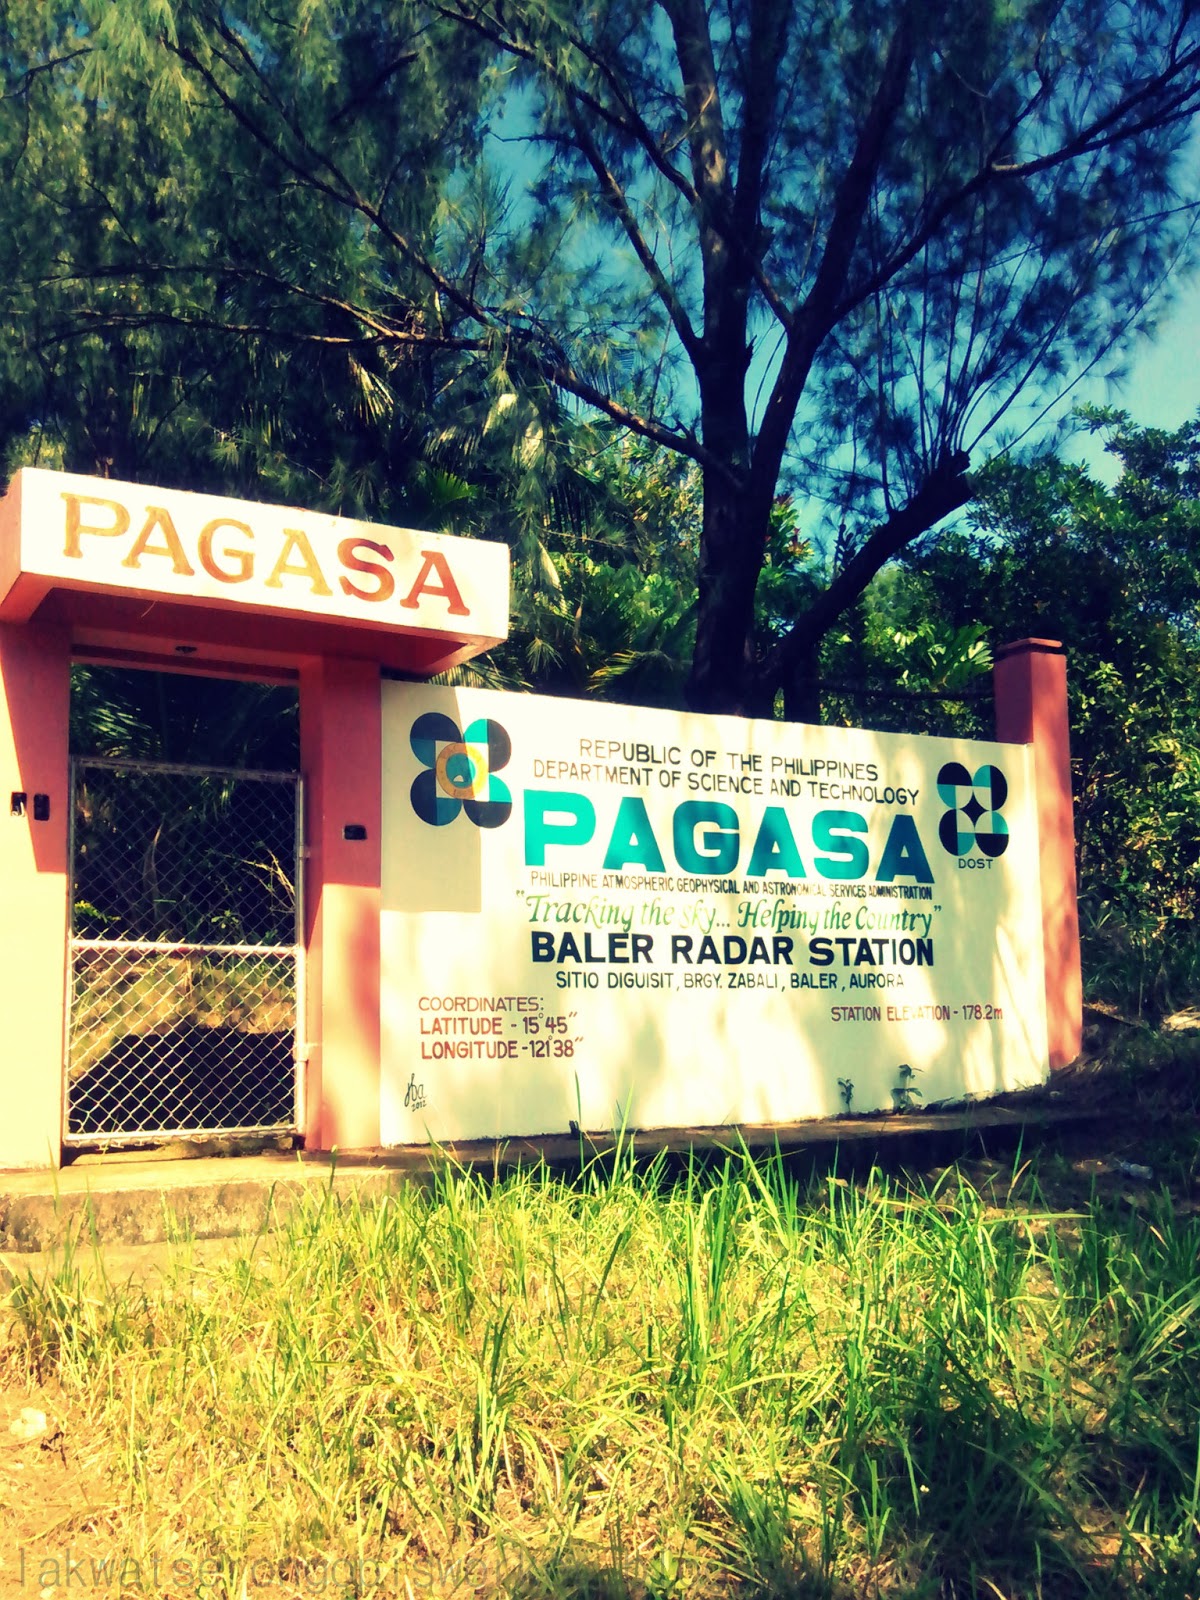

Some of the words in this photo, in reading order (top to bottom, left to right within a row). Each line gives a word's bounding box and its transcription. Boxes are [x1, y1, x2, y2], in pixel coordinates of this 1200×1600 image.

[60, 492, 471, 616] PAGASA
[579, 738, 682, 765] REPUBLIC
[690, 748, 717, 768] OF
[726, 752, 763, 772] THE
[771, 756, 879, 782] PHILIPPINES
[533, 758, 654, 787] DEPARTMENT
[658, 769, 682, 788] OF
[687, 772, 764, 796] SCIENCE
[770, 778, 801, 797] AND
[807, 781, 920, 806] TECHNOLOGY
[523, 788, 936, 885] PAGASA
[958, 858, 994, 870] DOST
[530, 870, 598, 889] PHILIPPINE
[602, 874, 674, 892] ATMOSPHERIC
[676, 877, 740, 895] GEOPHYSICAL
[743, 880, 760, 896] AND
[829, 883, 867, 898] SERVICES
[868, 885, 933, 901] ADMINISTRATION
[640, 898, 675, 927] the
[738, 898, 820, 936] Helping
[823, 900, 851, 930] the
[531, 930, 654, 964] BALER
[671, 934, 794, 965] RADAR
[808, 937, 935, 967] STATION
[556, 971, 599, 989] SITIO
[684, 972, 723, 989] BRGY.
[849, 973, 905, 989] AURORA
[418, 996, 544, 1013] COORDINATES:
[831, 1006, 881, 1022] STATION
[962, 1003, 1003, 1020] 178.2m
[420, 1017, 503, 1035] LATITUDE
[421, 1040, 519, 1060] LONGITUDE
